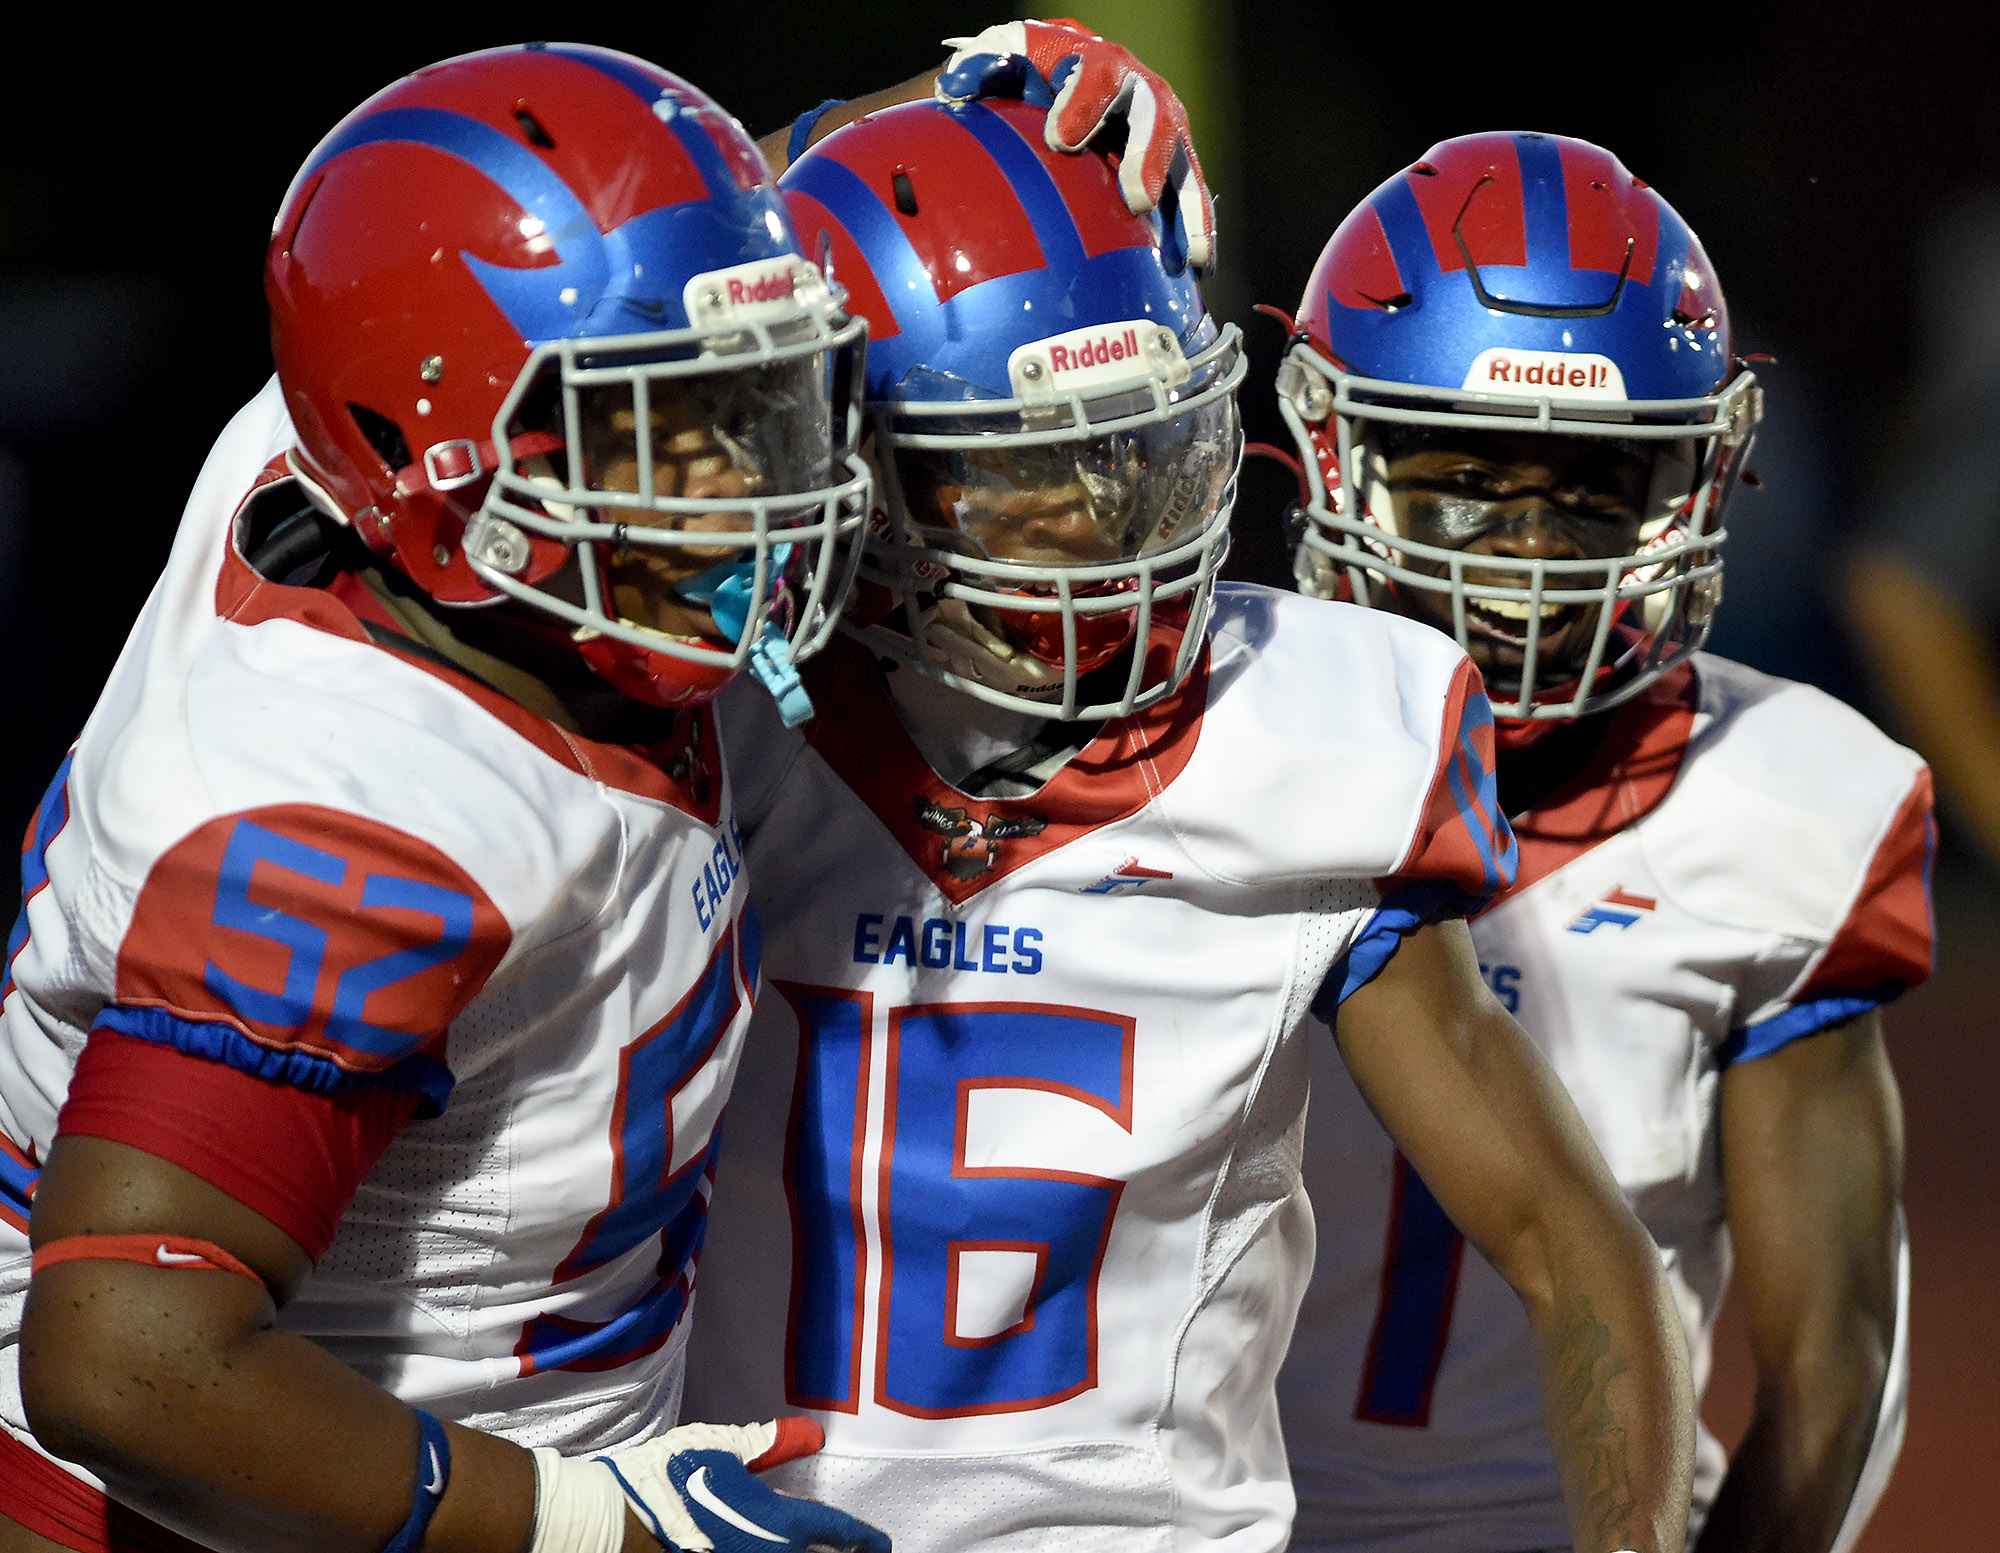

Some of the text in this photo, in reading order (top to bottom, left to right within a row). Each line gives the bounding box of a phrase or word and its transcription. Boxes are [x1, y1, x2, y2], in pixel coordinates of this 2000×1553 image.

[1049, 328, 1138, 372] Riddell
[1488, 354, 1608, 388] Riddell
[1016, 683, 1066, 692] Ridde
[921, 808, 954, 830] WINGS
[204, 816, 474, 1057] 52
[853, 912, 1043, 976] EAGLES
[767, 978, 1137, 1419] 16
